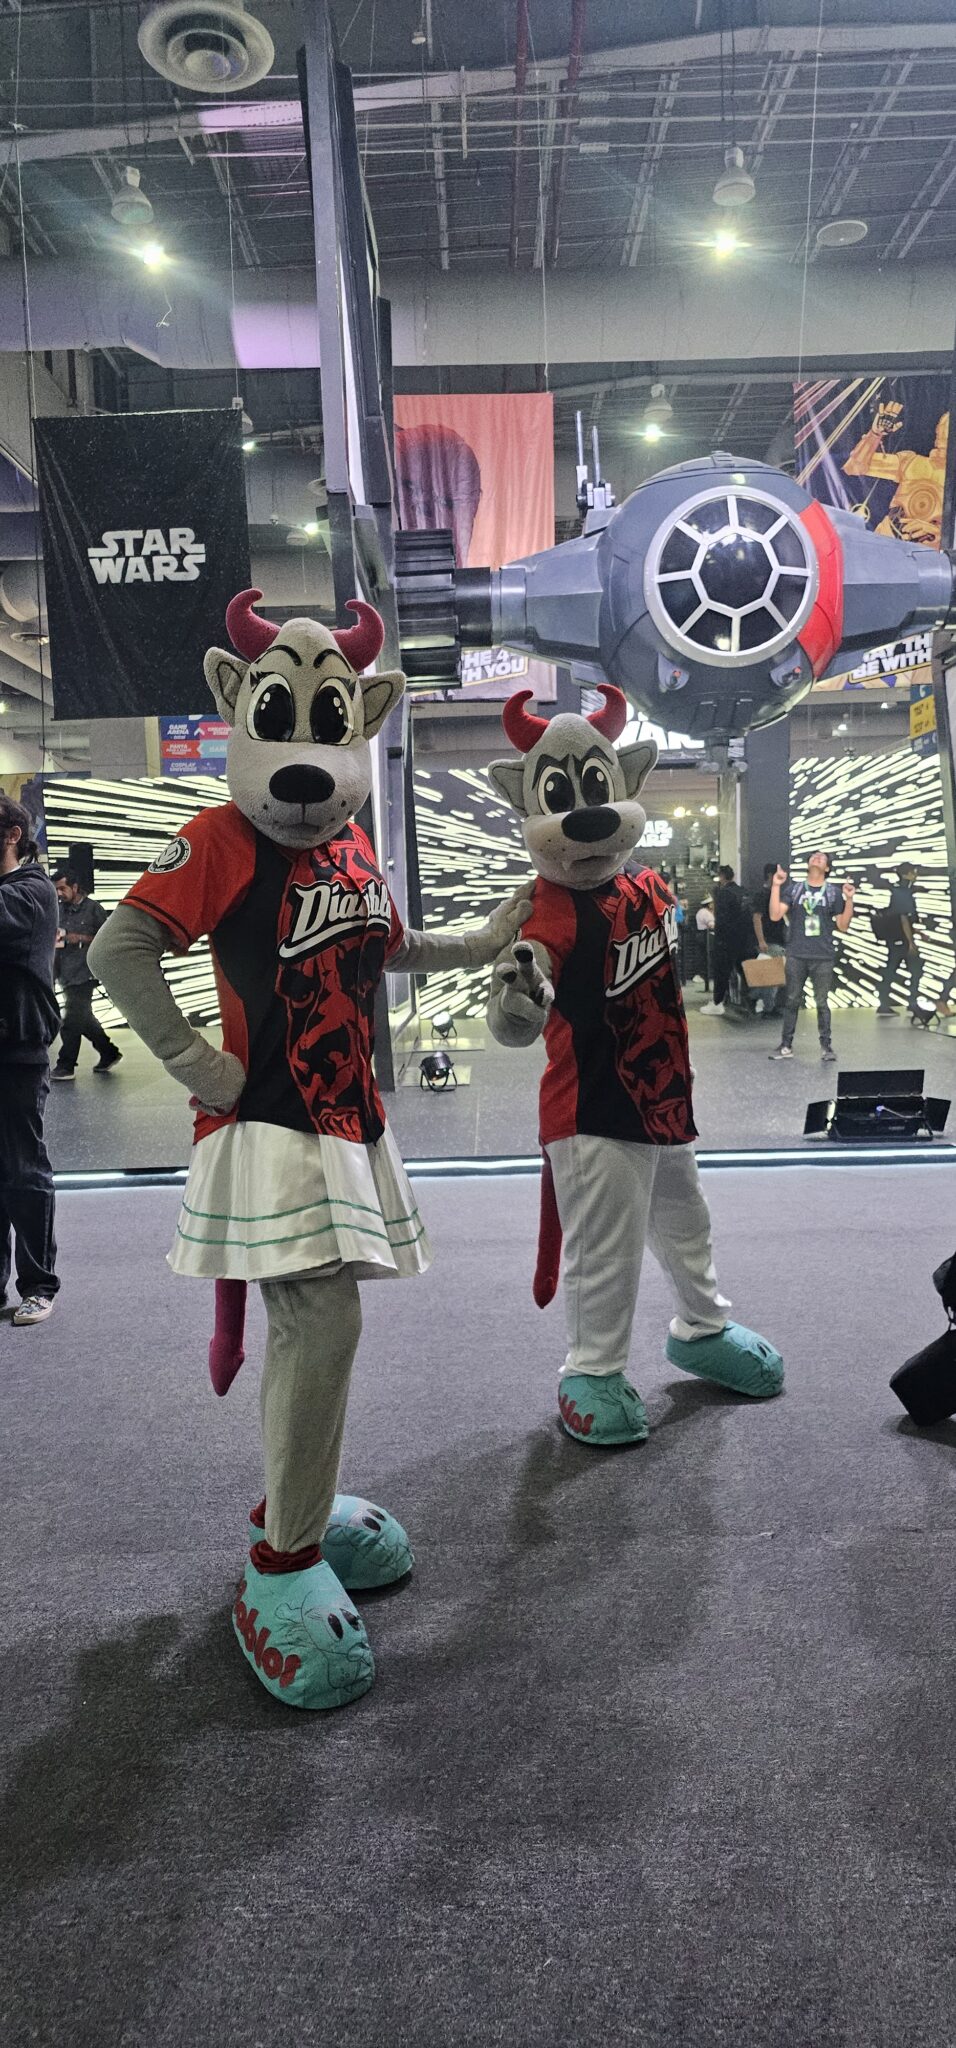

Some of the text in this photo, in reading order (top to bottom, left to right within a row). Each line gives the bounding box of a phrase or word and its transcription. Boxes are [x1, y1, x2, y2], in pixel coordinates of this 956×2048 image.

[87, 527, 206, 557] STAR
[89, 554, 206, 584] WARS
[484, 656, 525, 678] YOU
[880, 648, 932, 672] WITH
